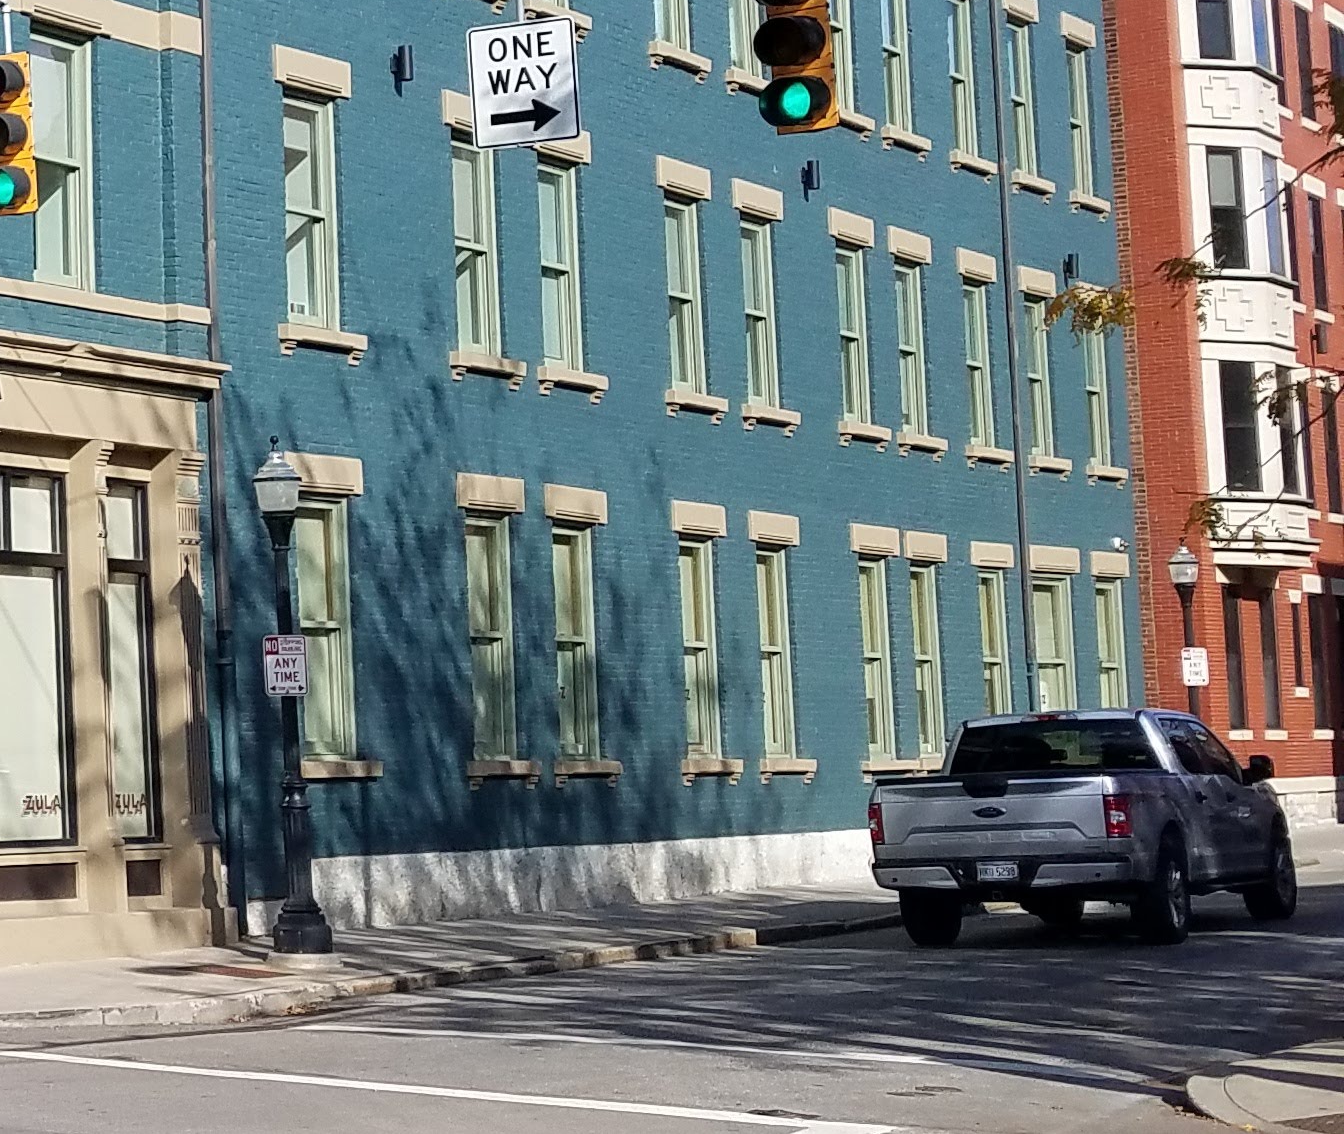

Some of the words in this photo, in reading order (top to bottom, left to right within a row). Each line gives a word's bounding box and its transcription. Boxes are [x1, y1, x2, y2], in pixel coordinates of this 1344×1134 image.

[488, 31, 555, 62] ONE
[488, 62, 557, 95] WAY
[265, 640, 278, 652] NO
[274, 658, 298, 669] ANY
[274, 671, 300, 683] TIME
[24, 795, 62, 811] ZULA
[115, 794, 148, 808] ZULA
